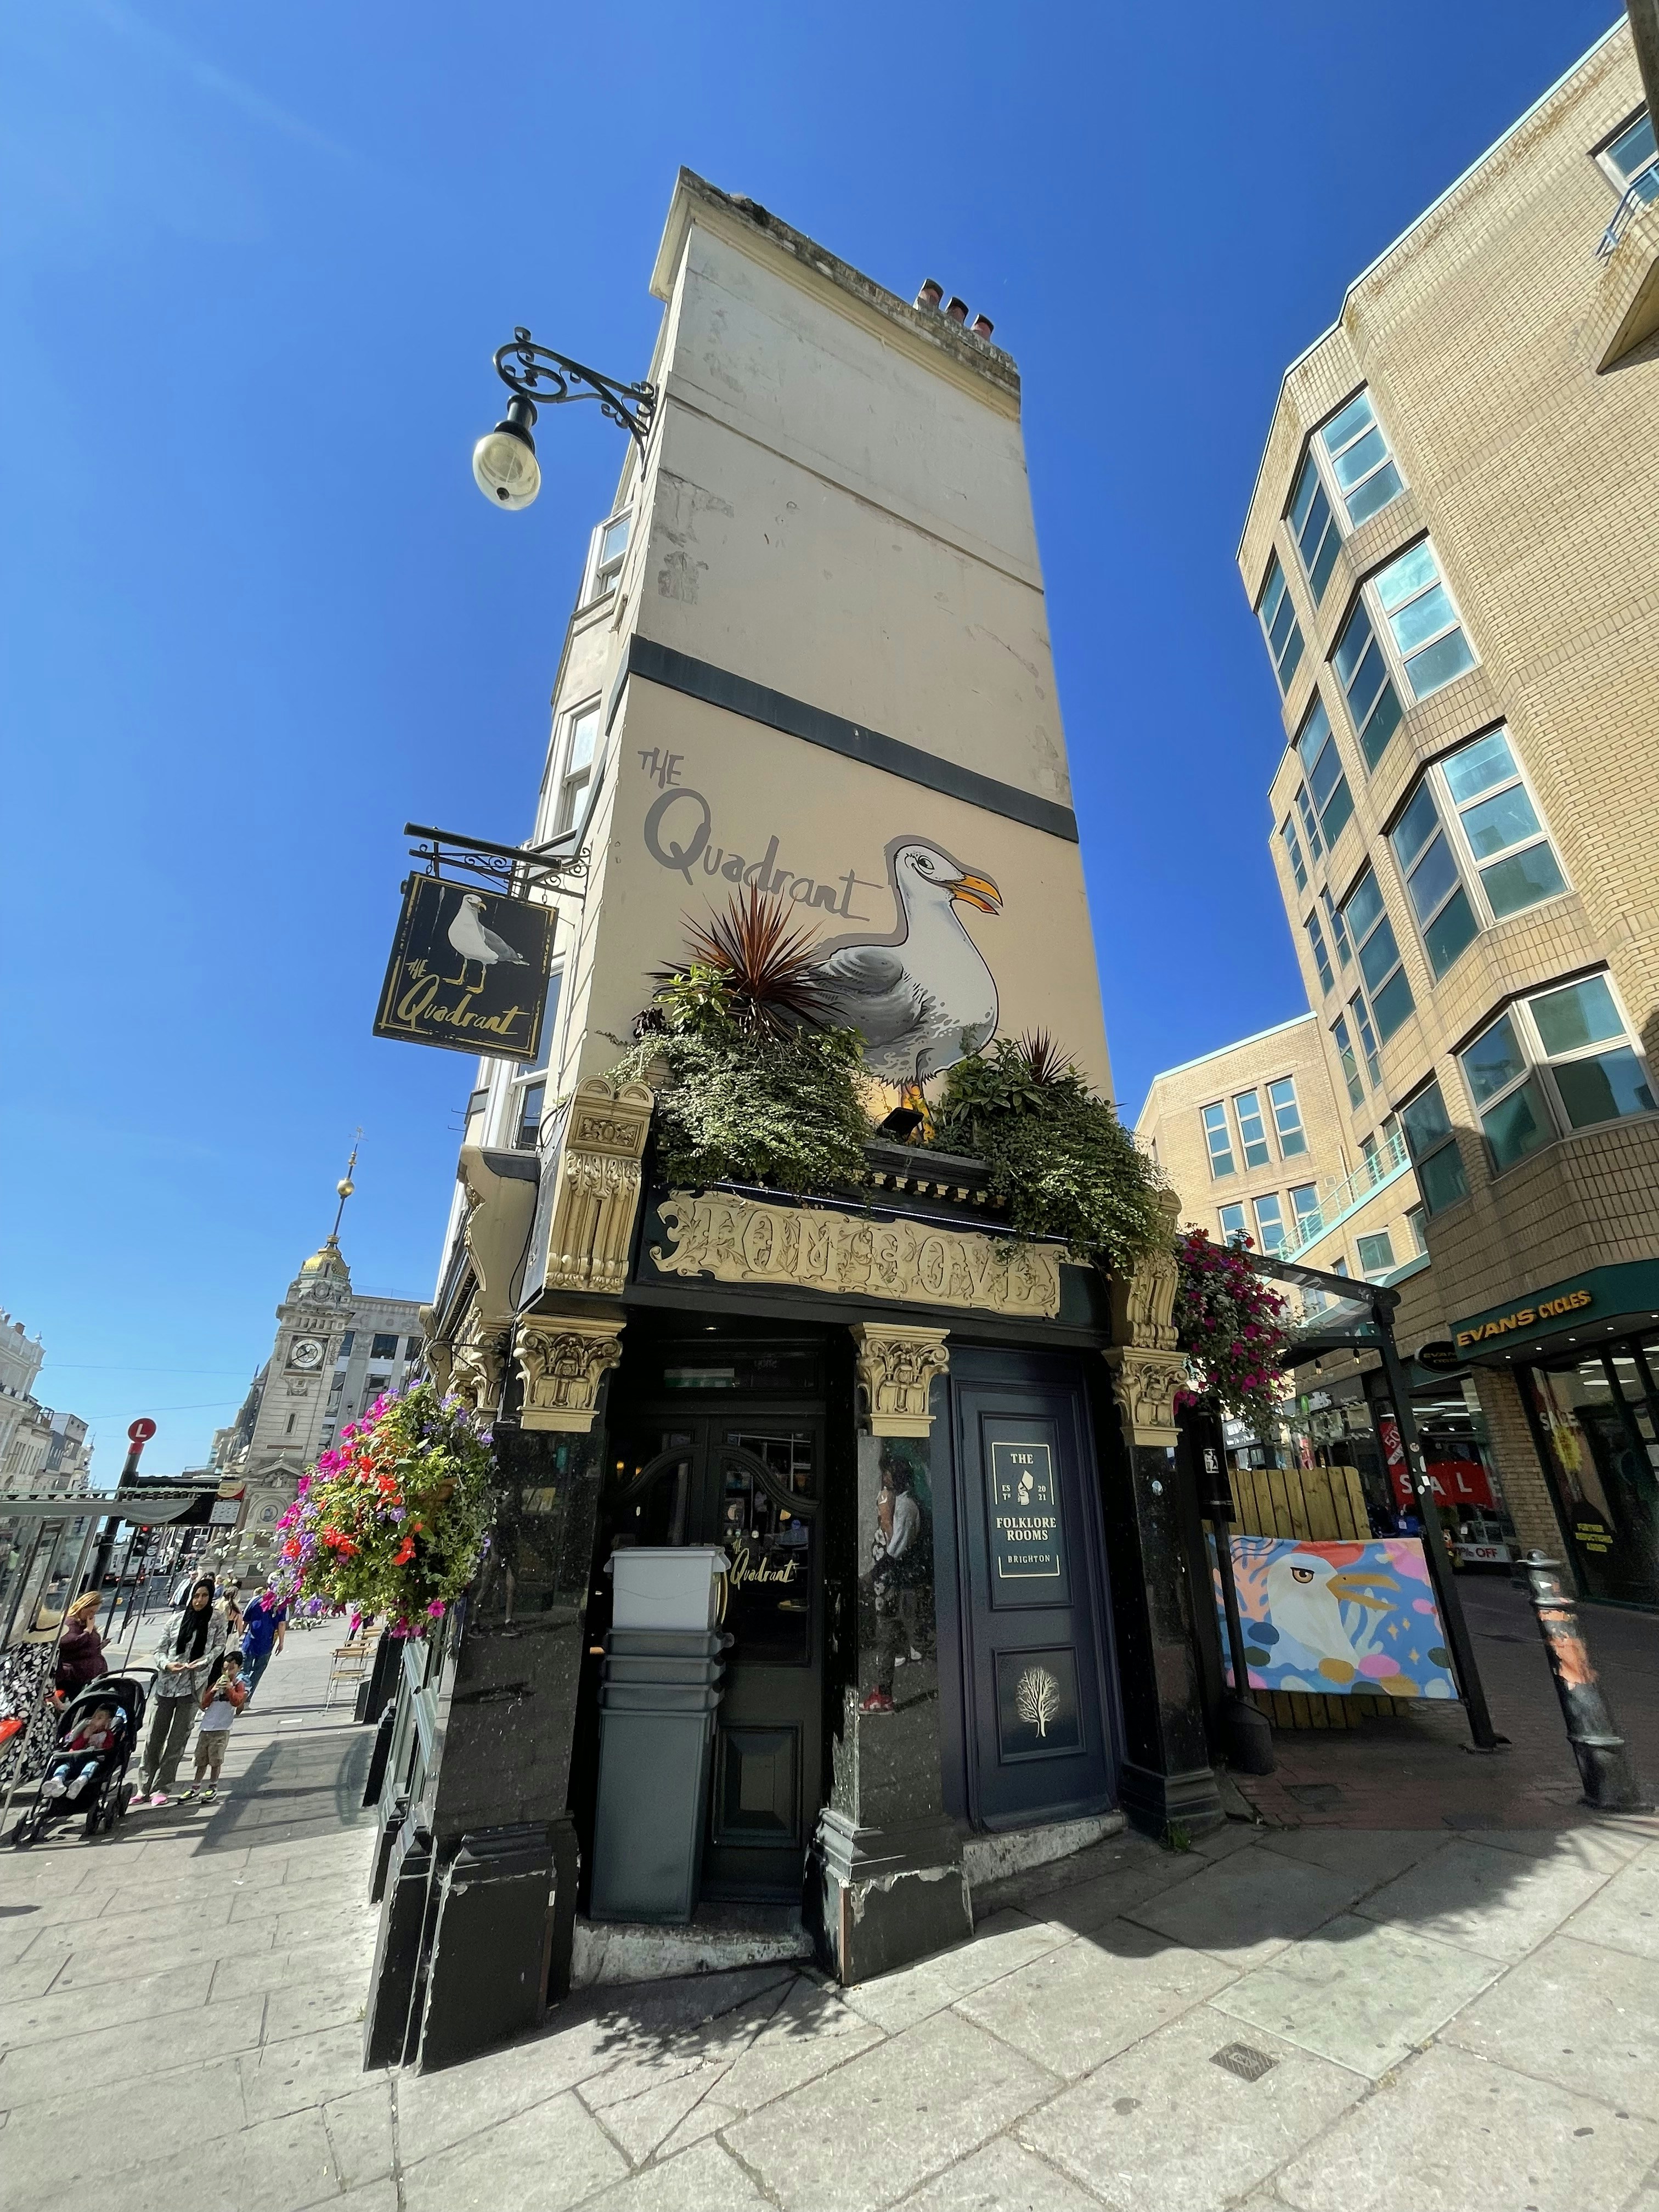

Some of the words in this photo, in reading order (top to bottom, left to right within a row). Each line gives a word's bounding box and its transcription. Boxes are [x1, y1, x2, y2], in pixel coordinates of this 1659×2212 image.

[637, 747, 684, 789] THE
[644, 788, 884, 922] Quadrant
[405, 958, 428, 979] THE
[397, 974, 531, 1035] Quadrant
[1457, 1308, 1536, 1347] EVANS
[1538, 1290, 1591, 1318] CYCLES
[135, 1423, 148, 1437] L
[1010, 1453, 1034, 1464] THE
[996, 1517, 1057, 1529] FOLKLORE
[1006, 1530, 1048, 1541] ROOMS
[1007, 1554, 1051, 1564] BRIGHTON
[1475, 1547, 1498, 1558] OFF
[730, 1548, 800, 1590] Quadrant
